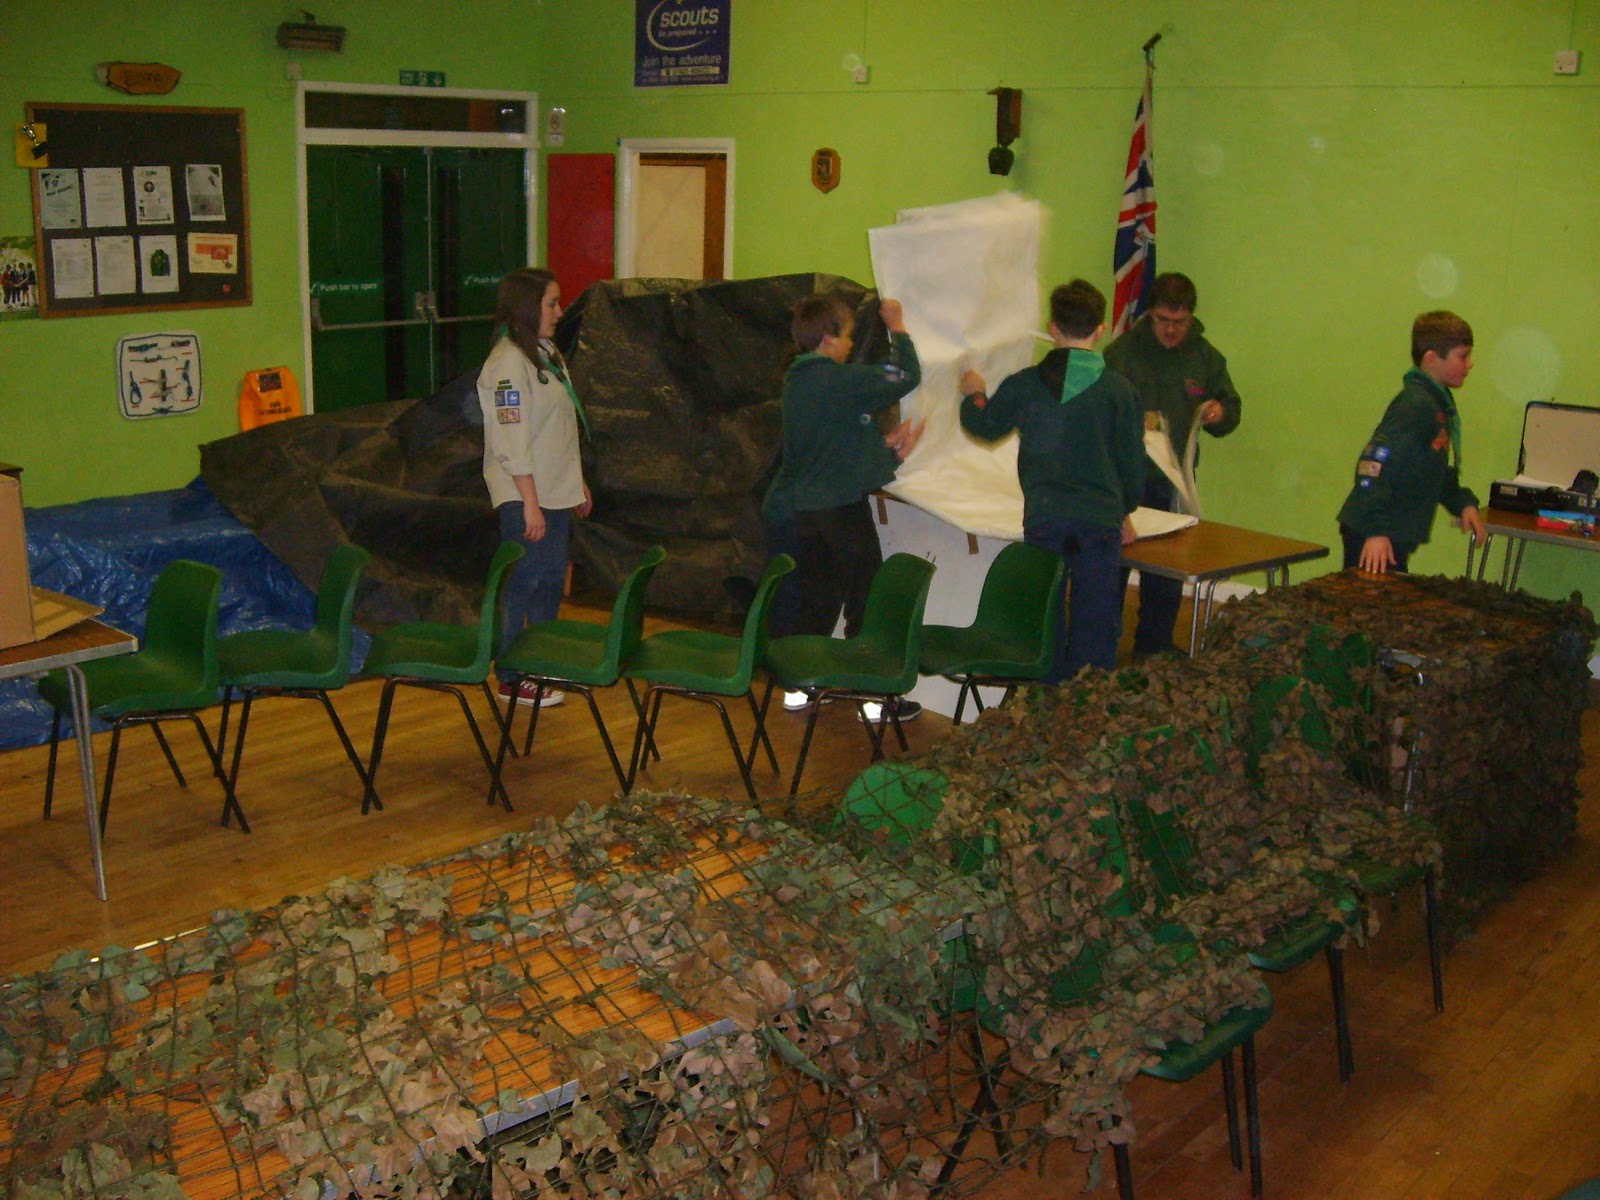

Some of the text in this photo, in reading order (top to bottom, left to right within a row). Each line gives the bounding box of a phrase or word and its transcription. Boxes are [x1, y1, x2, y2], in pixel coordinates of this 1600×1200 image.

[660, 6, 720, 28] scouts
[319, 283, 338, 292] Push
[360, 282, 378, 291] open
